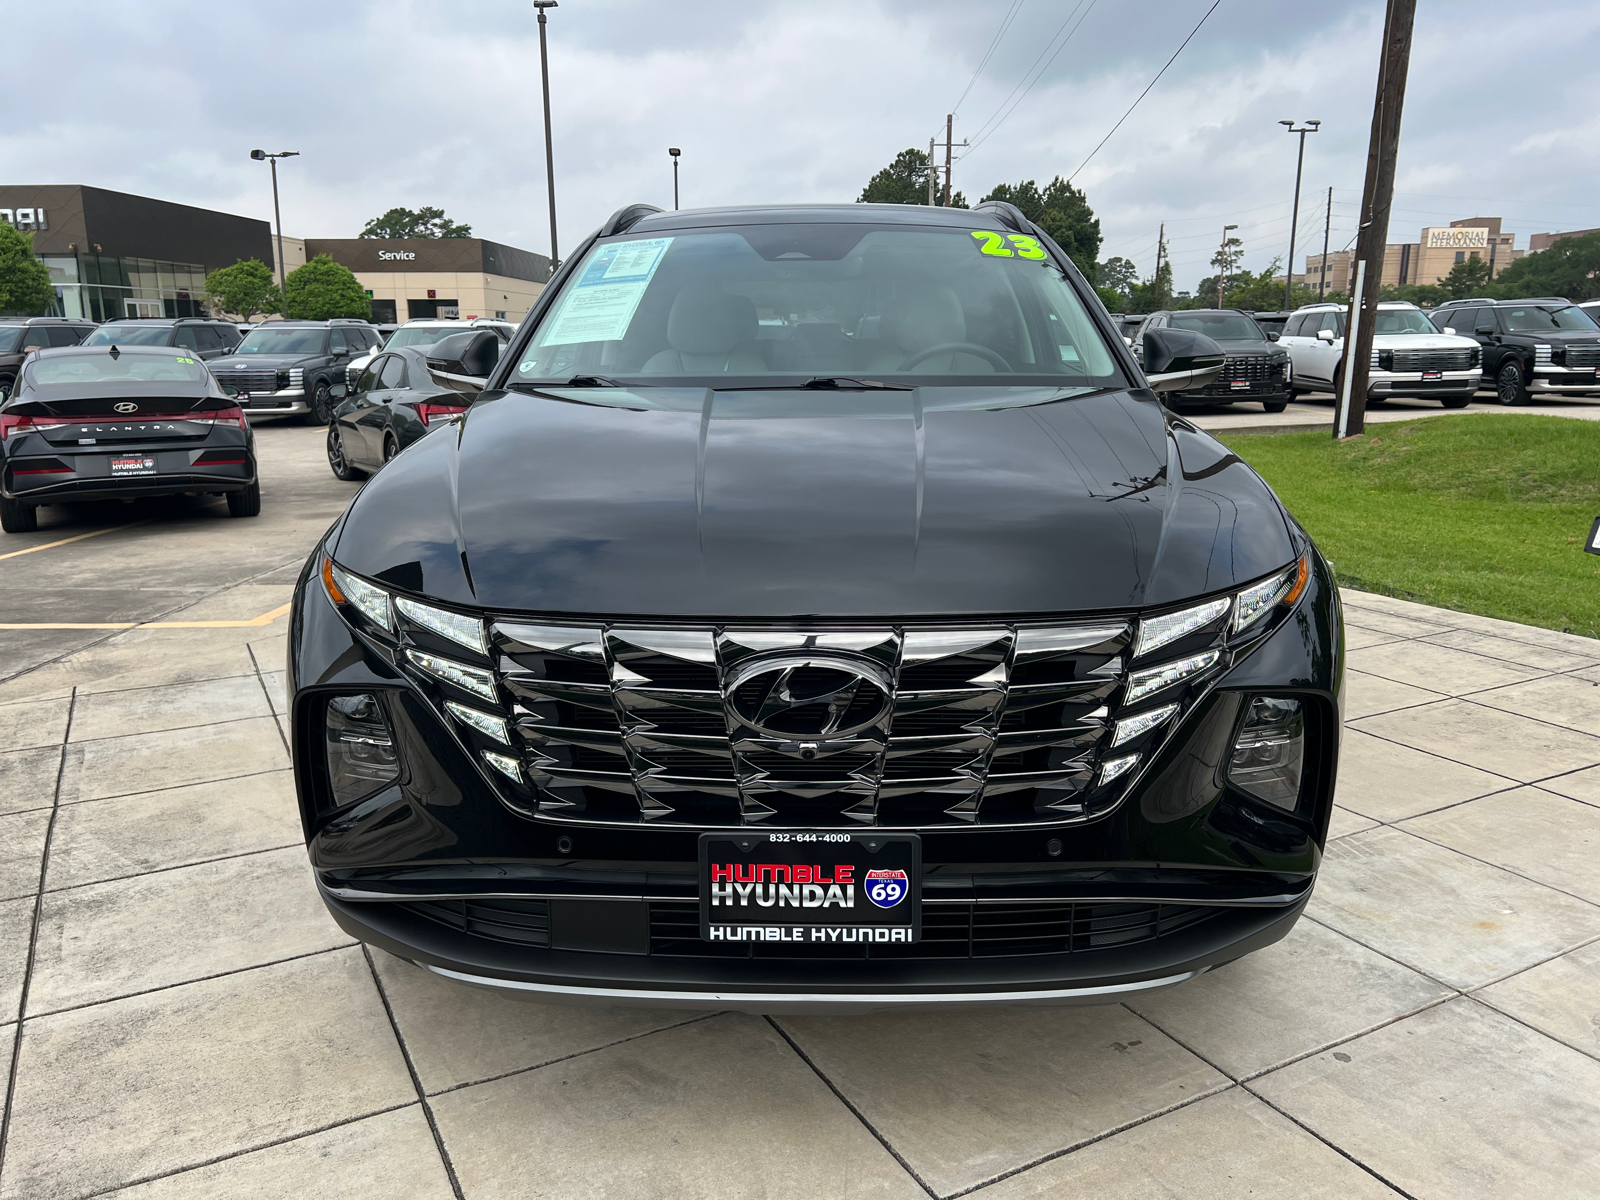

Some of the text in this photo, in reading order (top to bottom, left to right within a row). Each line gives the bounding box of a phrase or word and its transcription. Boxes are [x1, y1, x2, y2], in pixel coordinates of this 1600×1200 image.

[1431, 231, 1485, 240] MEMORIAL
[971, 231, 1048, 261] 23
[1431, 238, 1485, 247] HERMANN
[378, 250, 416, 261] Service
[81, 424, 175, 432] ELANTRA
[769, 833, 851, 843] 832-644-4000
[711, 863, 855, 884] HUMBLE
[711, 882, 855, 908] HYUNDAI
[871, 883, 901, 901] 69
[709, 926, 913, 942] HUMBLE HYUNDAI
